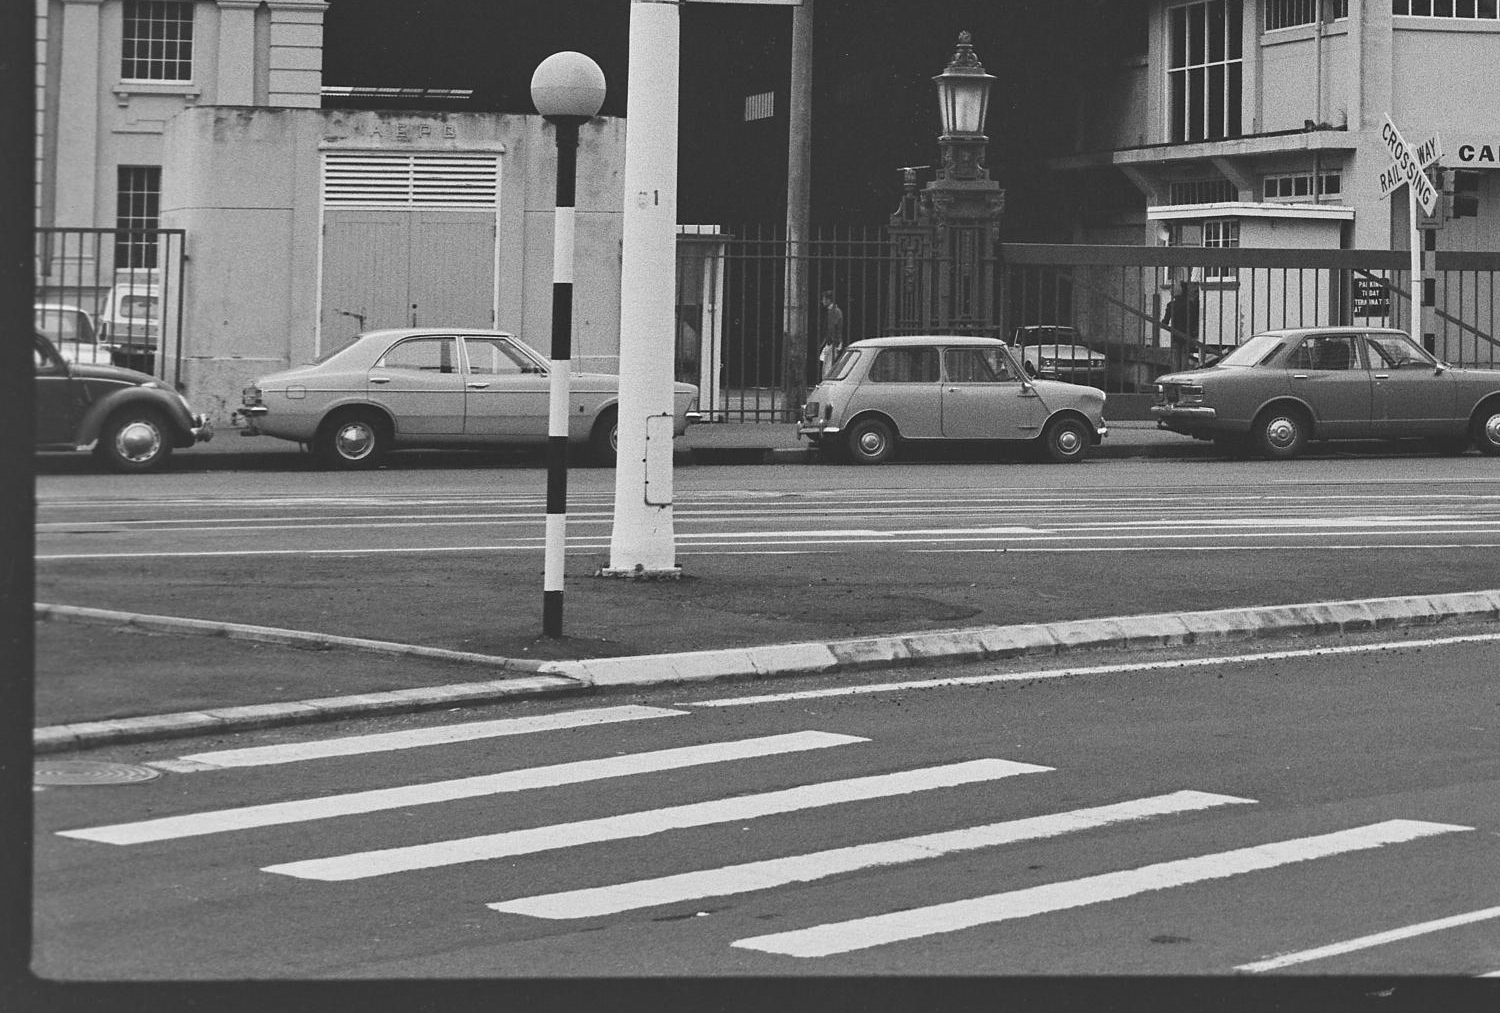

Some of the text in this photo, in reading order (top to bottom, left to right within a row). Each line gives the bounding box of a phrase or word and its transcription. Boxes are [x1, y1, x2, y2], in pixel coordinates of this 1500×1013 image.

[1380, 137, 1436, 193] RAIL WAY
[1382, 122, 1432, 206] CROSSING
